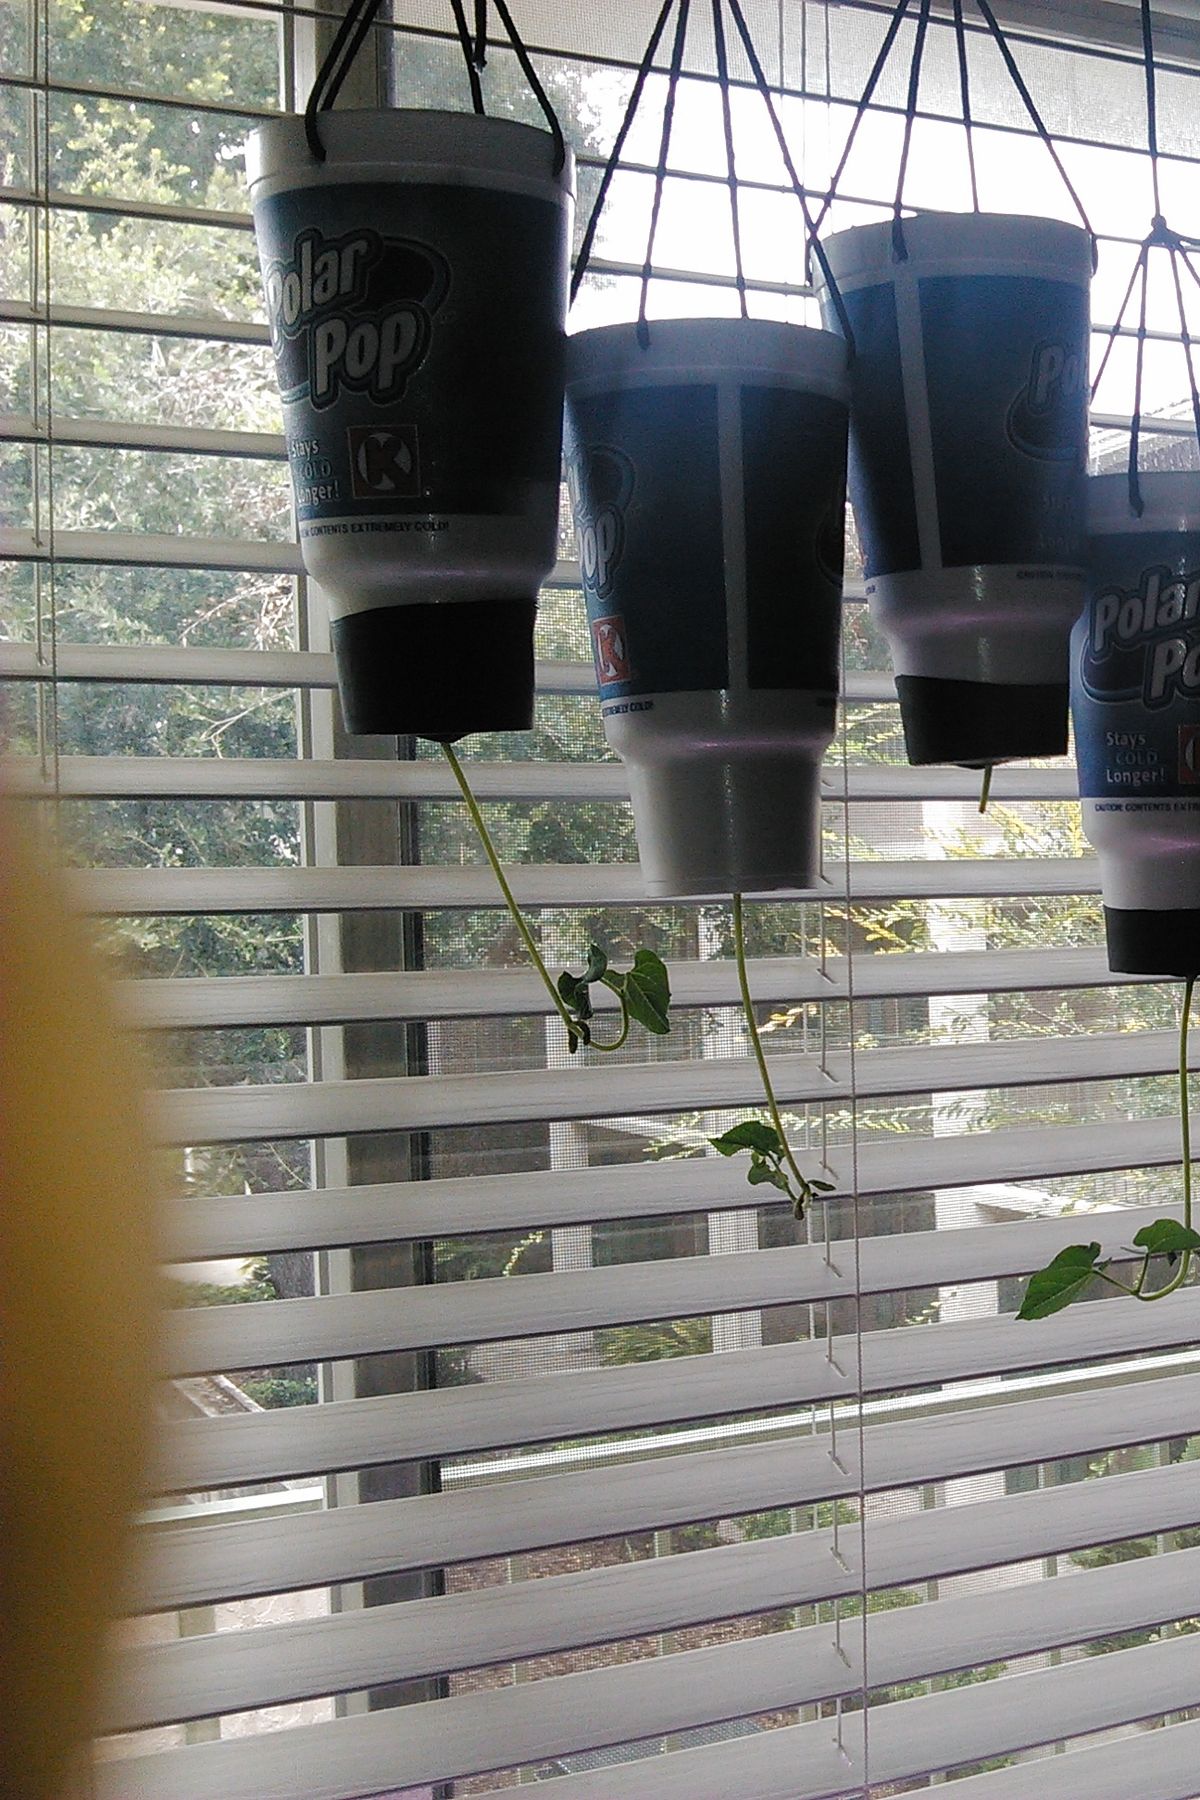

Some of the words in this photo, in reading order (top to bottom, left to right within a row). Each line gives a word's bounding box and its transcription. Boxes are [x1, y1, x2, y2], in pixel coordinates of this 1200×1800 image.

[313, 310, 418, 396] Pop
[1106, 731, 1147, 750] Stays
[1115, 751, 1159, 767] COLD
[1106, 767, 1166, 788] Longer!
